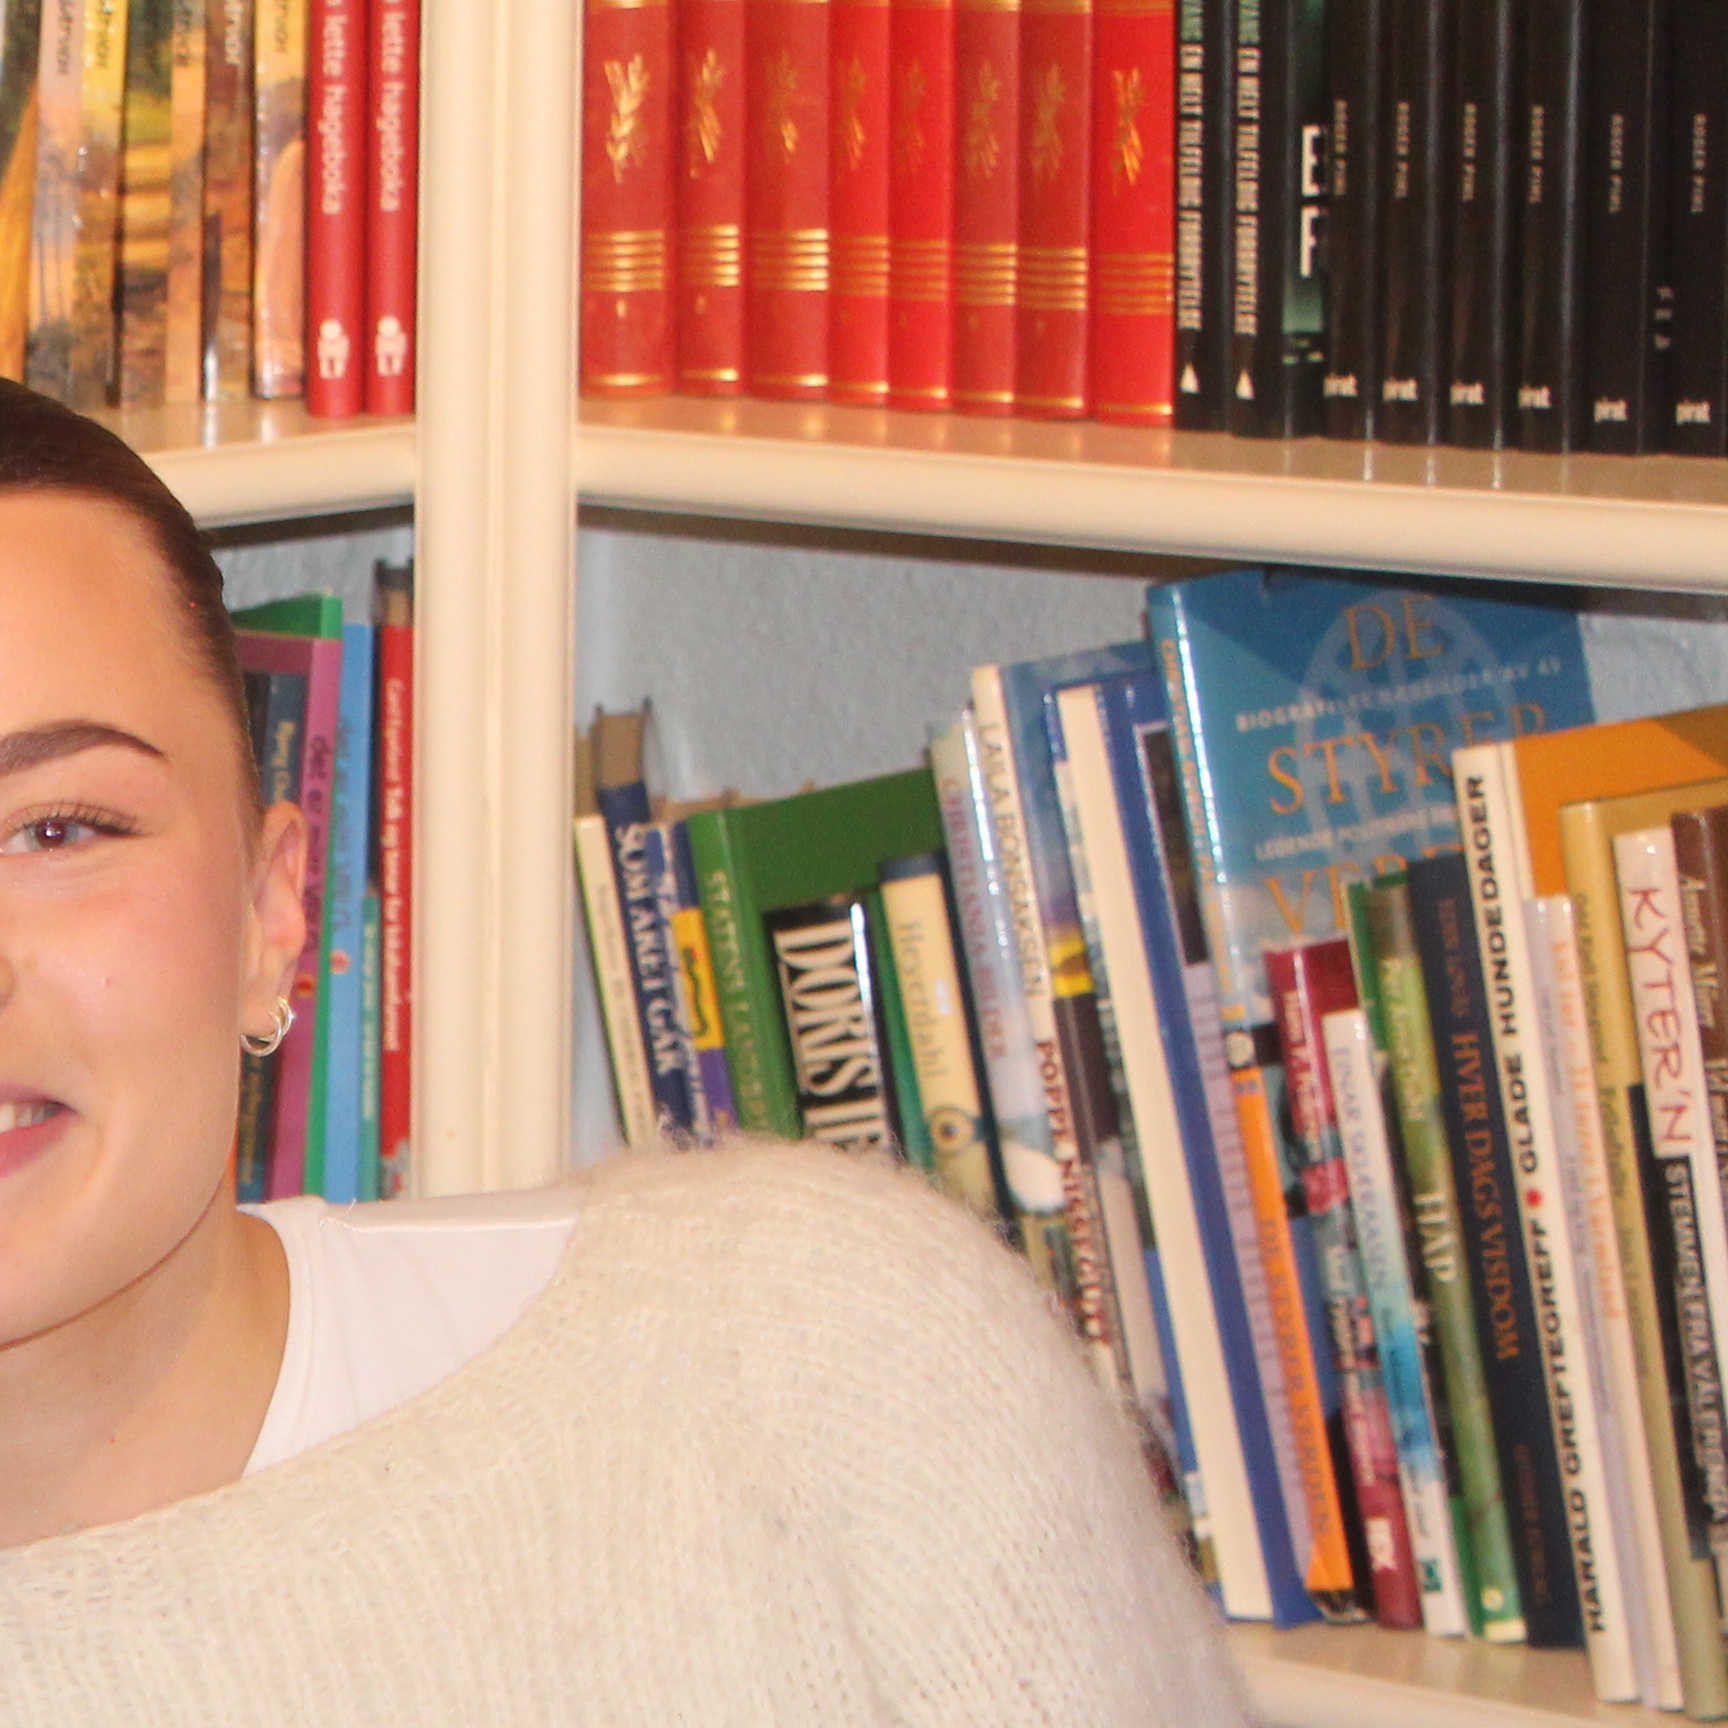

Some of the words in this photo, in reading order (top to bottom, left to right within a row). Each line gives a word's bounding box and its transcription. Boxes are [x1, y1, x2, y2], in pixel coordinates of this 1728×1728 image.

[323, 15, 349, 77] lette
[382, 12, 407, 74] lette
[318, 86, 348, 215] hageboka
[377, 81, 406, 213] hageboka
[1345, 593, 1446, 672] DE
[1466, 775, 1525, 1037] HUNDEDAGER
[772, 926, 886, 1098] DORIS
[1627, 886, 1694, 1146] KYTER'N
[1452, 1032, 1487, 1125] HVER
[1505, 1051, 1540, 1175] GLADE
[1464, 1129, 1498, 1216] DAGS
[1663, 1160, 1698, 1292] STEMMEN
[1480, 1222, 1522, 1361] VISDOM
[1528, 1222, 1585, 1478] GREFTEGREFF
[1563, 1486, 1607, 1633] HARALD
